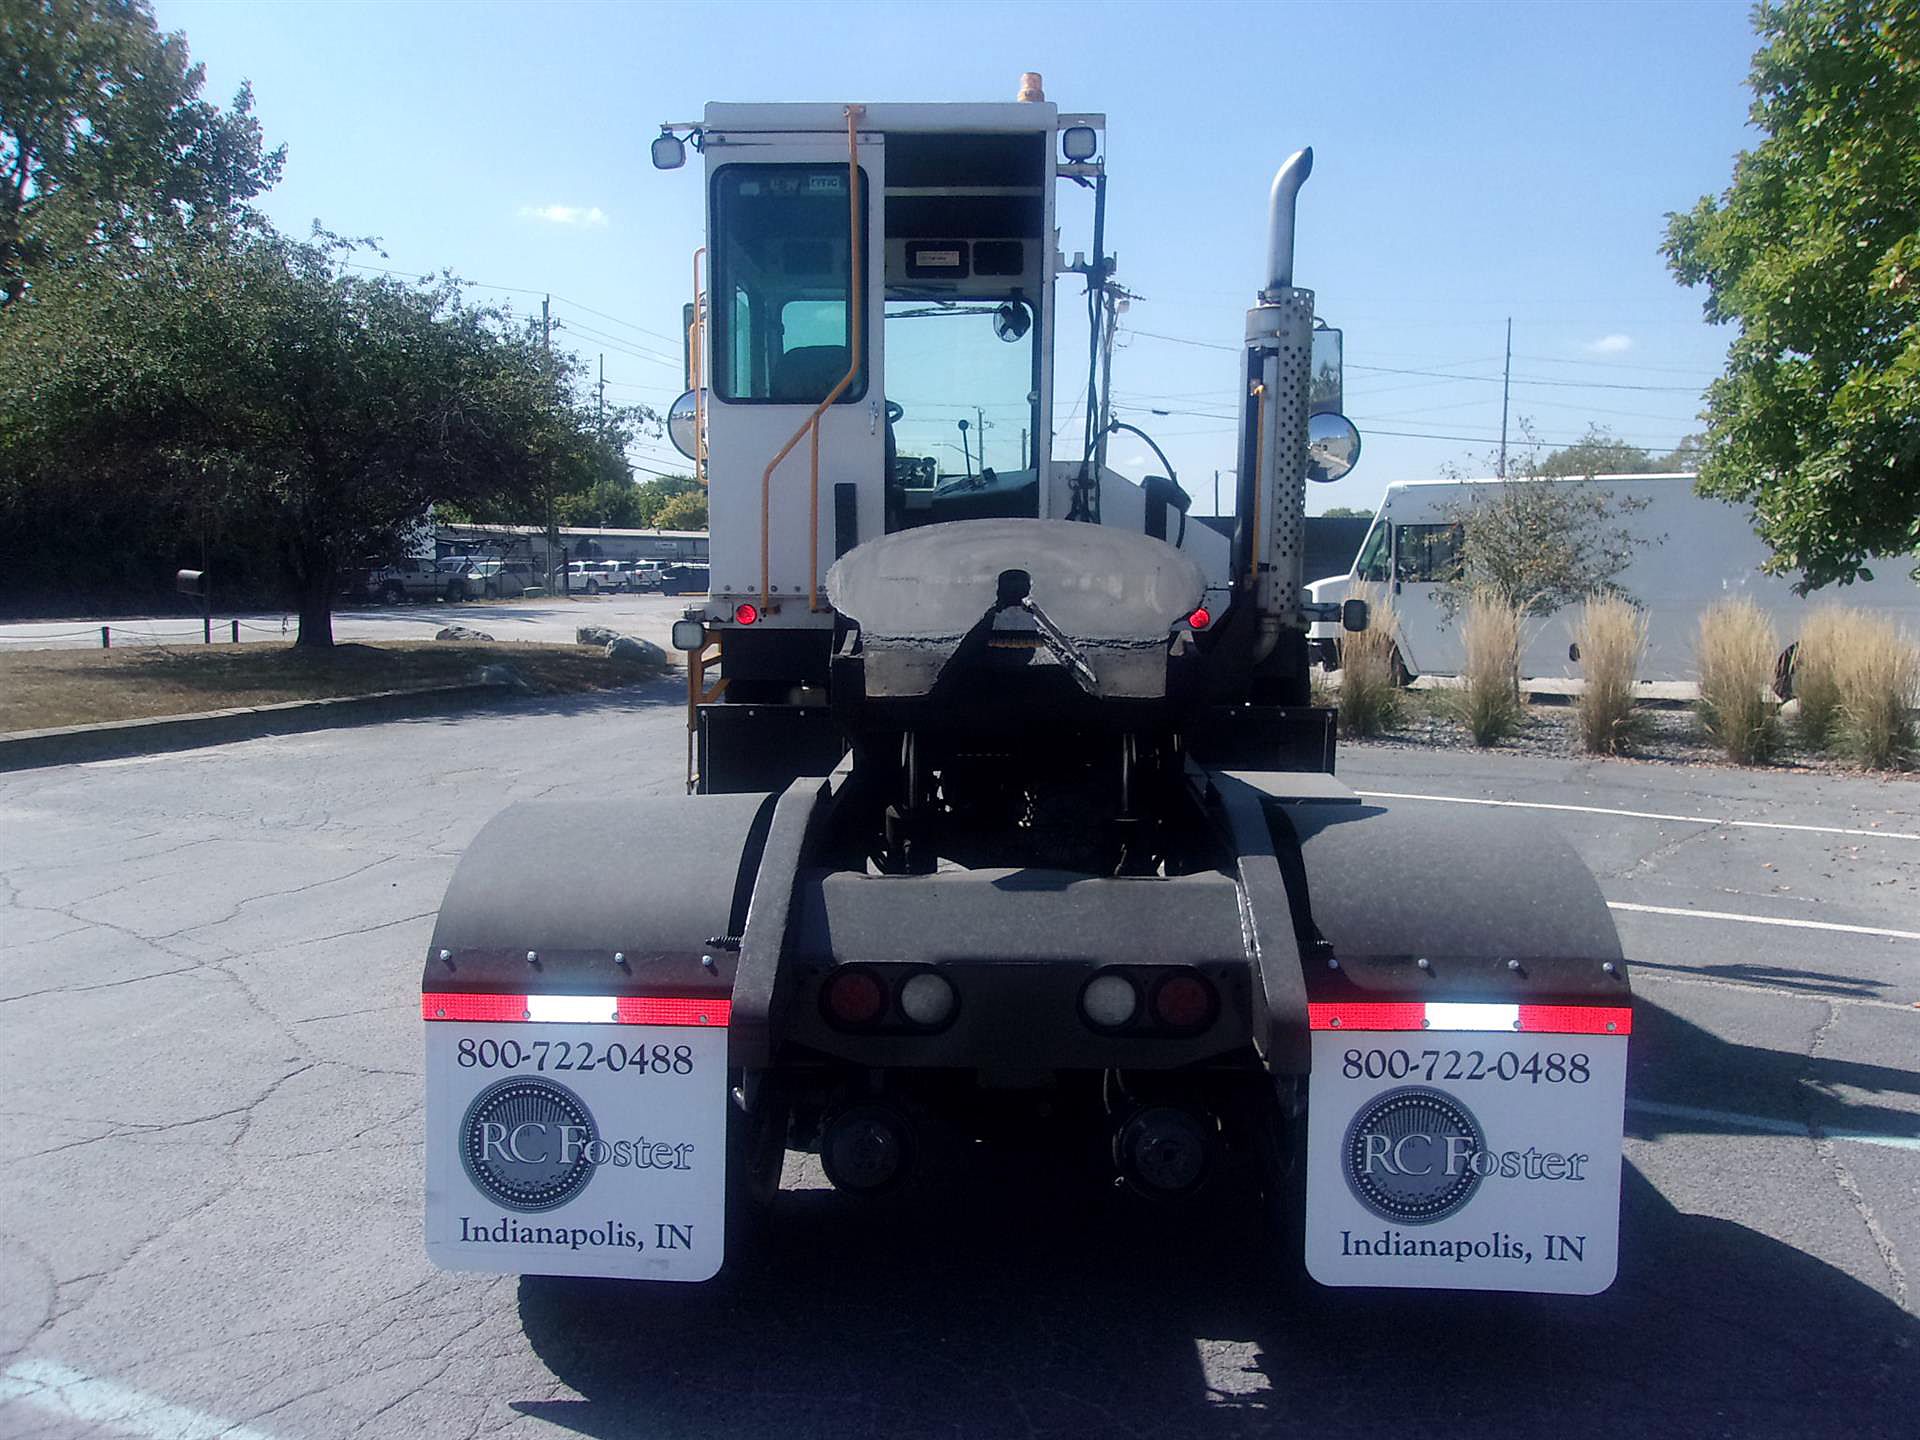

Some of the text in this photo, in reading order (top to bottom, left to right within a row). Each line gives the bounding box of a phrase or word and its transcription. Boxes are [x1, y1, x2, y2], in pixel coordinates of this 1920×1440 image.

[457, 1038, 694, 1075] 800-722-0488
[1342, 1049, 1591, 1084] 800-722-0488
[479, 1122, 695, 1170] RC Foster
[1363, 1134, 1589, 1181] RC Foster
[459, 1216, 694, 1252] Indianapolis, IN
[1340, 1230, 1587, 1264] Indianapolis, IN
